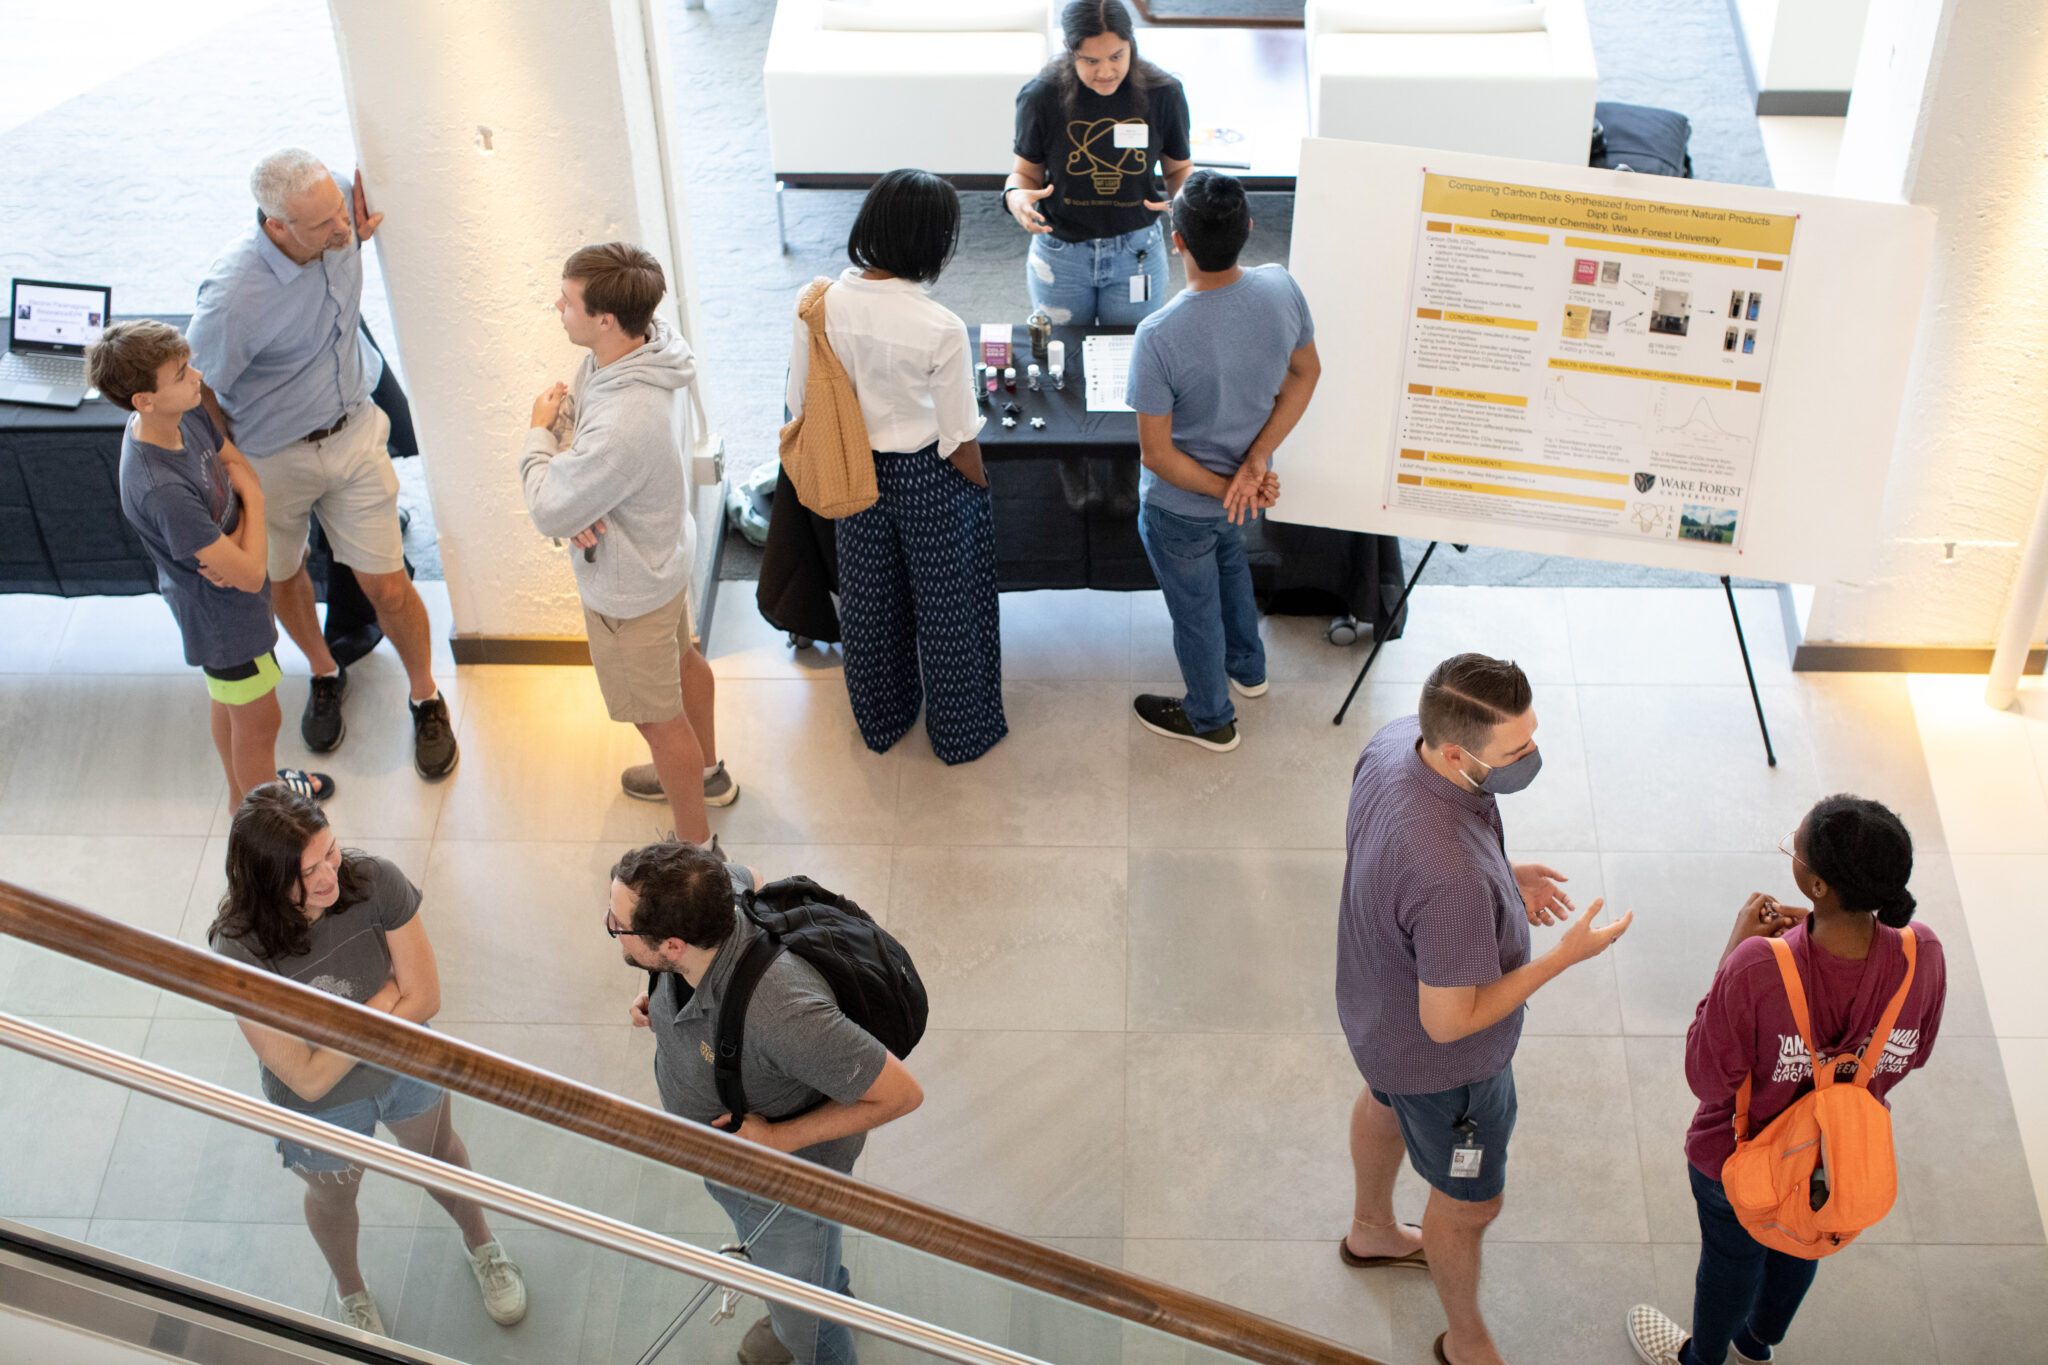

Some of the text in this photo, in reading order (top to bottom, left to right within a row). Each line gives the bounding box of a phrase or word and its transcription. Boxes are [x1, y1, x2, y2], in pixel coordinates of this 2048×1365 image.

[1447, 179, 1770, 226] Comparing Carbon Dots Synthesized from Different Natural Products
[1458, 225, 1505, 237] BACKGROUND
[1491, 208, 1545, 224] Department
[1547, 216, 1557, 224] of
[1612, 224, 1638, 234] Wake
[1641, 227, 1671, 238] Forest
[1674, 231, 1720, 245] University
[1448, 313, 1495, 324] CONCLUSIONS
[1439, 387, 1465, 396] FUTURE
[1659, 477, 1742, 496] WAKE FOREST
[1659, 489, 1724, 502] UNIVERSITY
